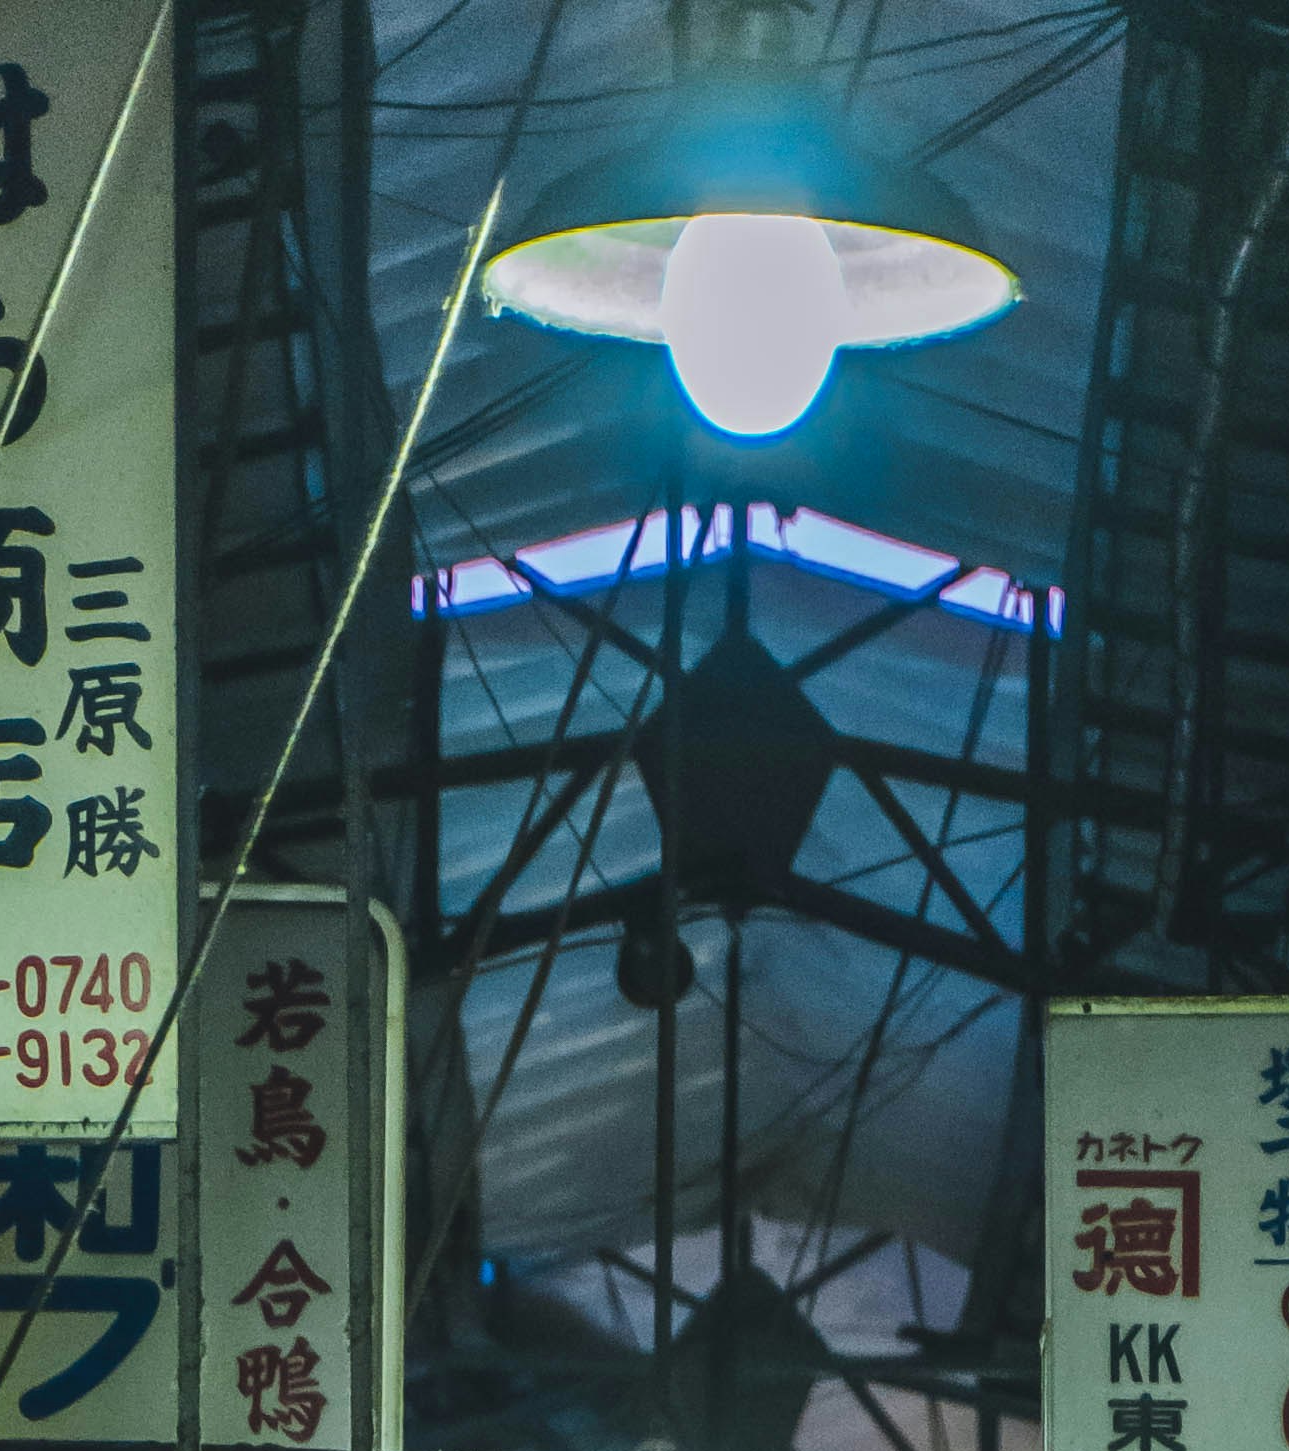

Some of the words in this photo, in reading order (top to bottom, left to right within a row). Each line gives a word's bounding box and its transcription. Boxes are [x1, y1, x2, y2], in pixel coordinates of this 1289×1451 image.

[57, 558, 160, 877] 三原勝
[1076, 1131, 1203, 1163] カネトク
